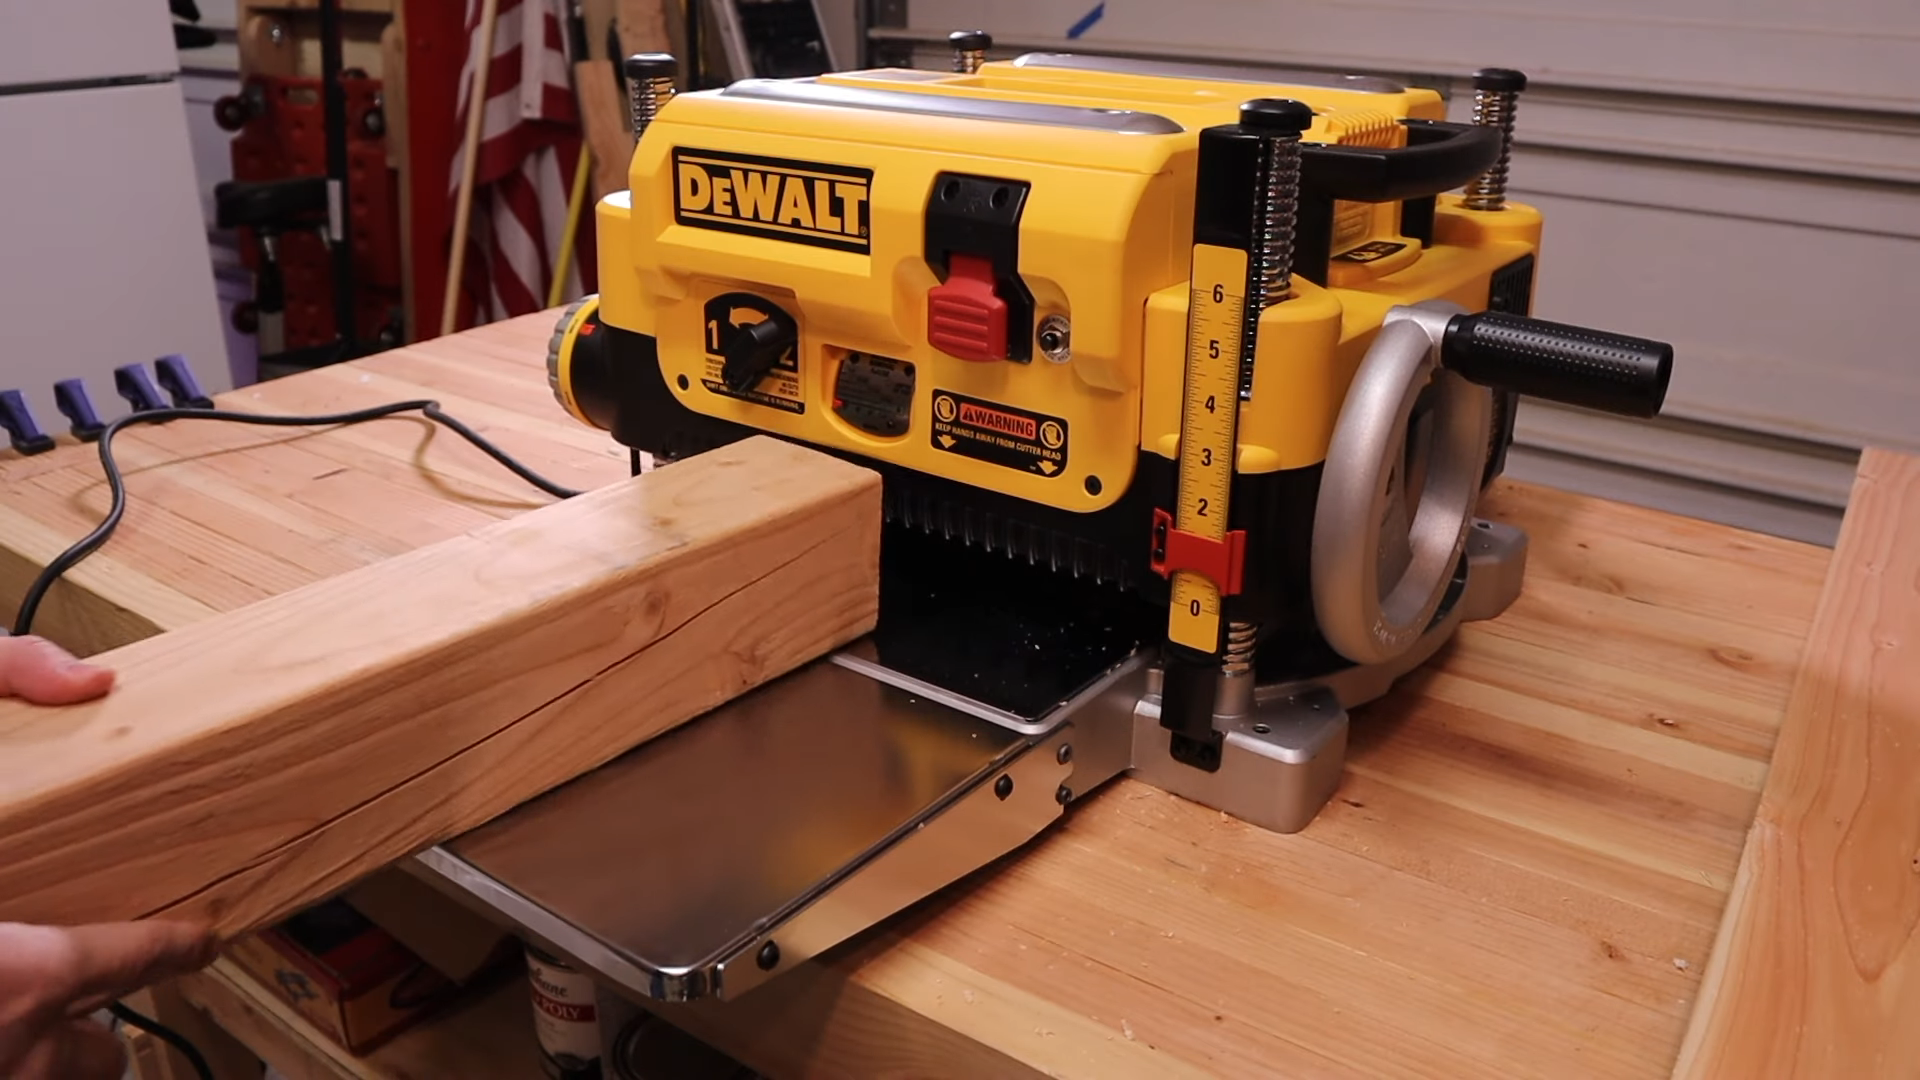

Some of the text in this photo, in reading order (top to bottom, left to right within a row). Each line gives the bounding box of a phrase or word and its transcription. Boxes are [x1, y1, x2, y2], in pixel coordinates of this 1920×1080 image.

[1212, 283, 1224, 304] 6
[708, 319, 719, 350] 1
[1208, 339, 1220, 360] 5
[1204, 394, 1216, 414] 4
[975, 409, 1034, 438] WARNING
[935, 422, 1062, 461] KEEP HANDS AWAY FROM CUTTER HEAD
[1200, 447, 1212, 467] 3
[1197, 497, 1209, 517] 2
[1189, 599, 1201, 617] 0
[542, 997, 581, 1020] POLY
